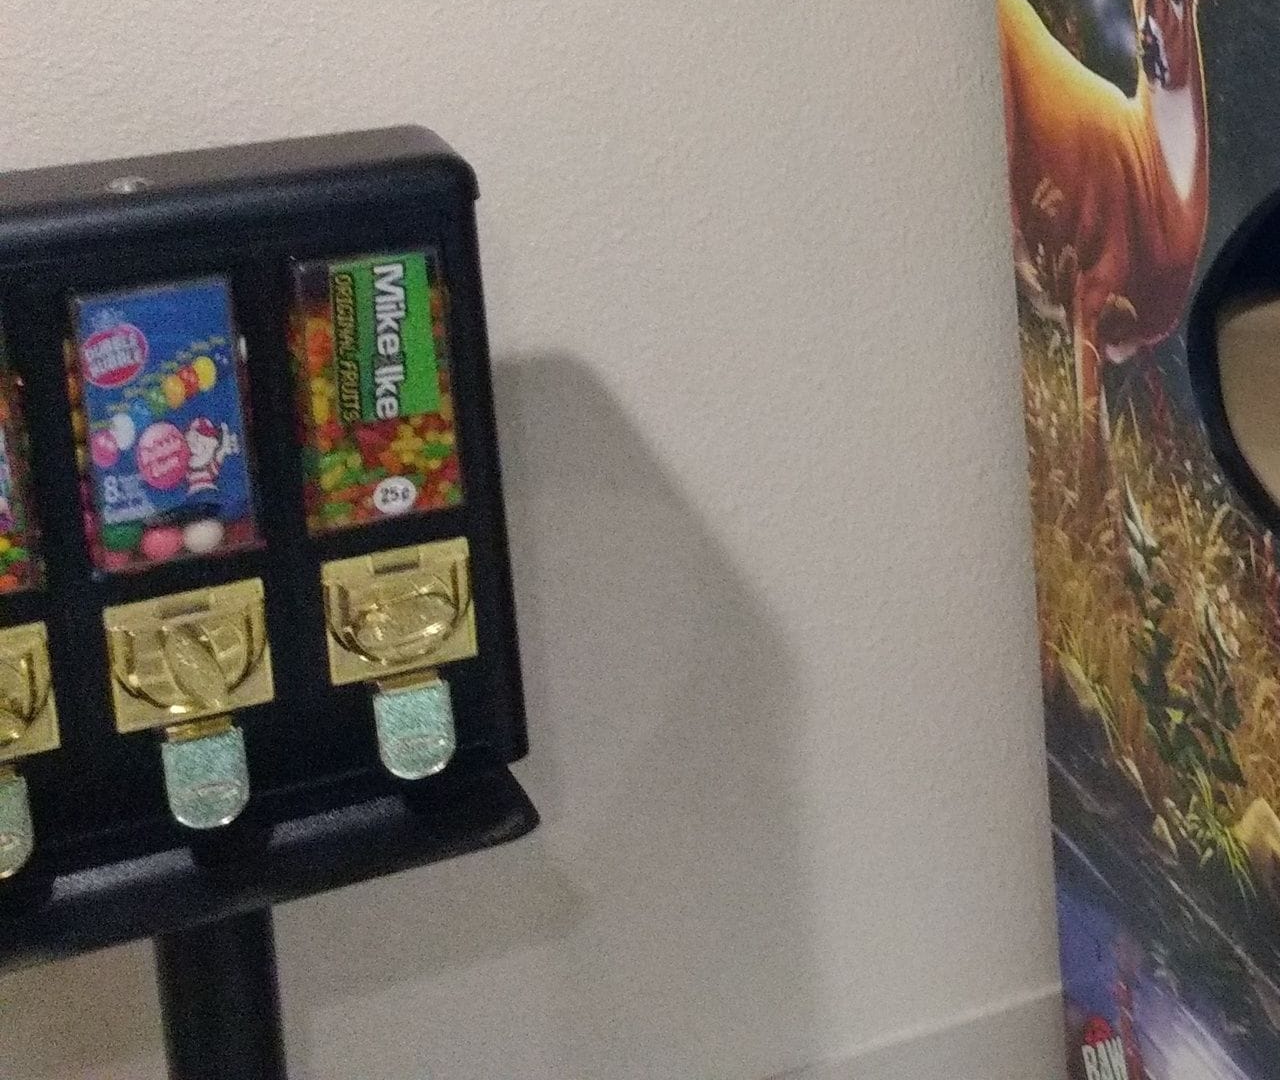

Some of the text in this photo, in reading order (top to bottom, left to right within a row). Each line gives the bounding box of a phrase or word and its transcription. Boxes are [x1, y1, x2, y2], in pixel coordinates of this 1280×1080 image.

[340, 359, 362, 421] FRUITS
[374, 263, 406, 420] Mike Ike
